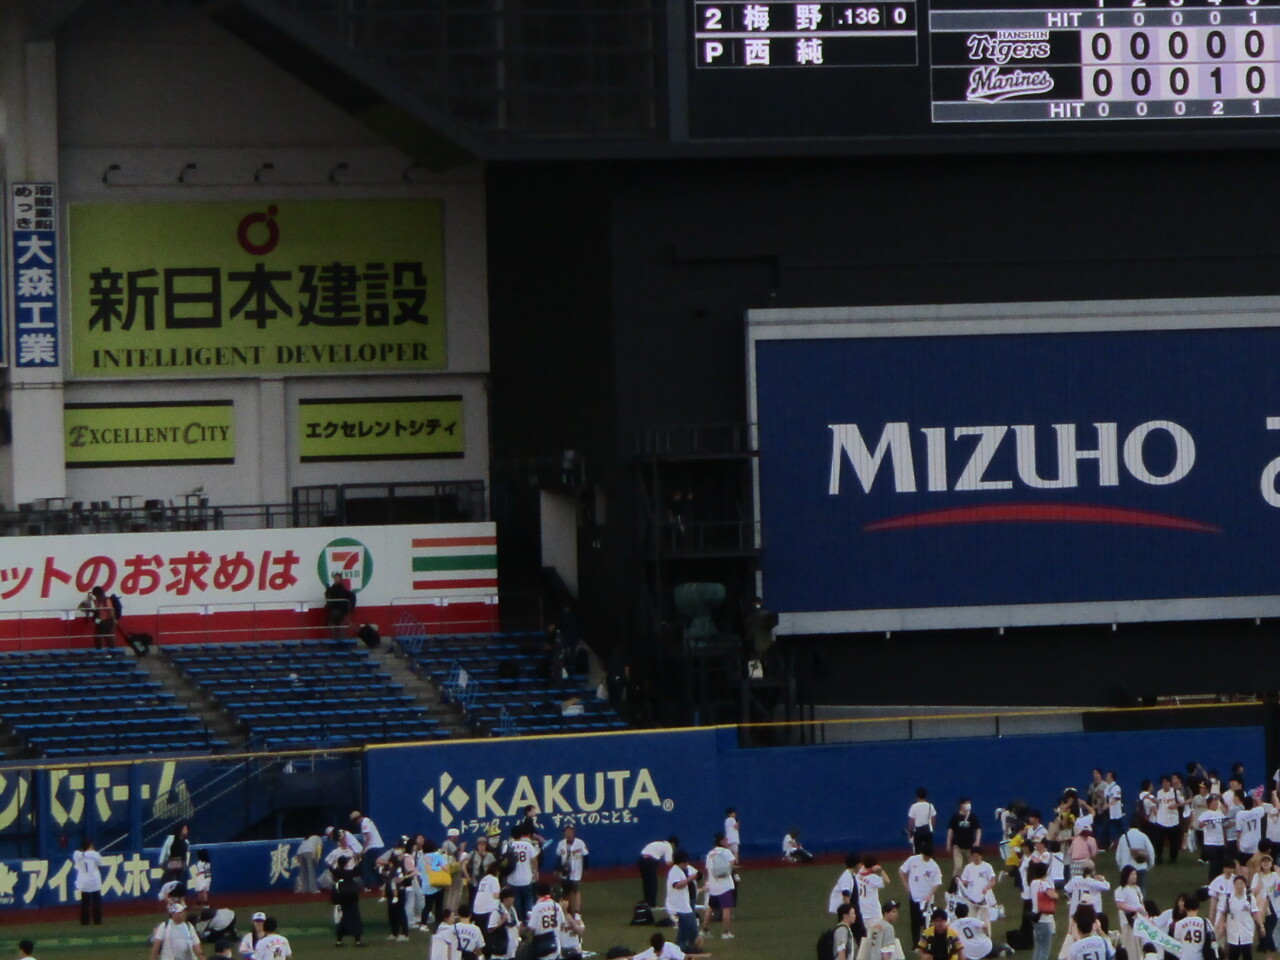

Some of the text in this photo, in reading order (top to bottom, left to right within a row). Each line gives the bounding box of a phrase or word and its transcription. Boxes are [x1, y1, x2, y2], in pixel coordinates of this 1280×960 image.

[838, 7, 880, 25] .136
[1047, 12, 1082, 28] HIT
[967, 34, 1051, 63] Tigers
[966, 65, 1054, 103] Marines
[1050, 102, 1086, 118] HIT
[15, 186, 32, 230] めっき
[17, 234, 55, 364] 大森工業
[89, 262, 429, 332] 新日本建設
[92, 342, 430, 368] INTELLIGENT DEVELOPER
[305, 419, 457, 439] エクセレントシティ
[827, 419, 1196, 495] MIZUHO
[0, 550, 300, 600] ットのお求めは
[476, 767, 662, 818] KAKUTA
[963, 926, 974, 940] 0
[1183, 928, 1203, 945] 49
